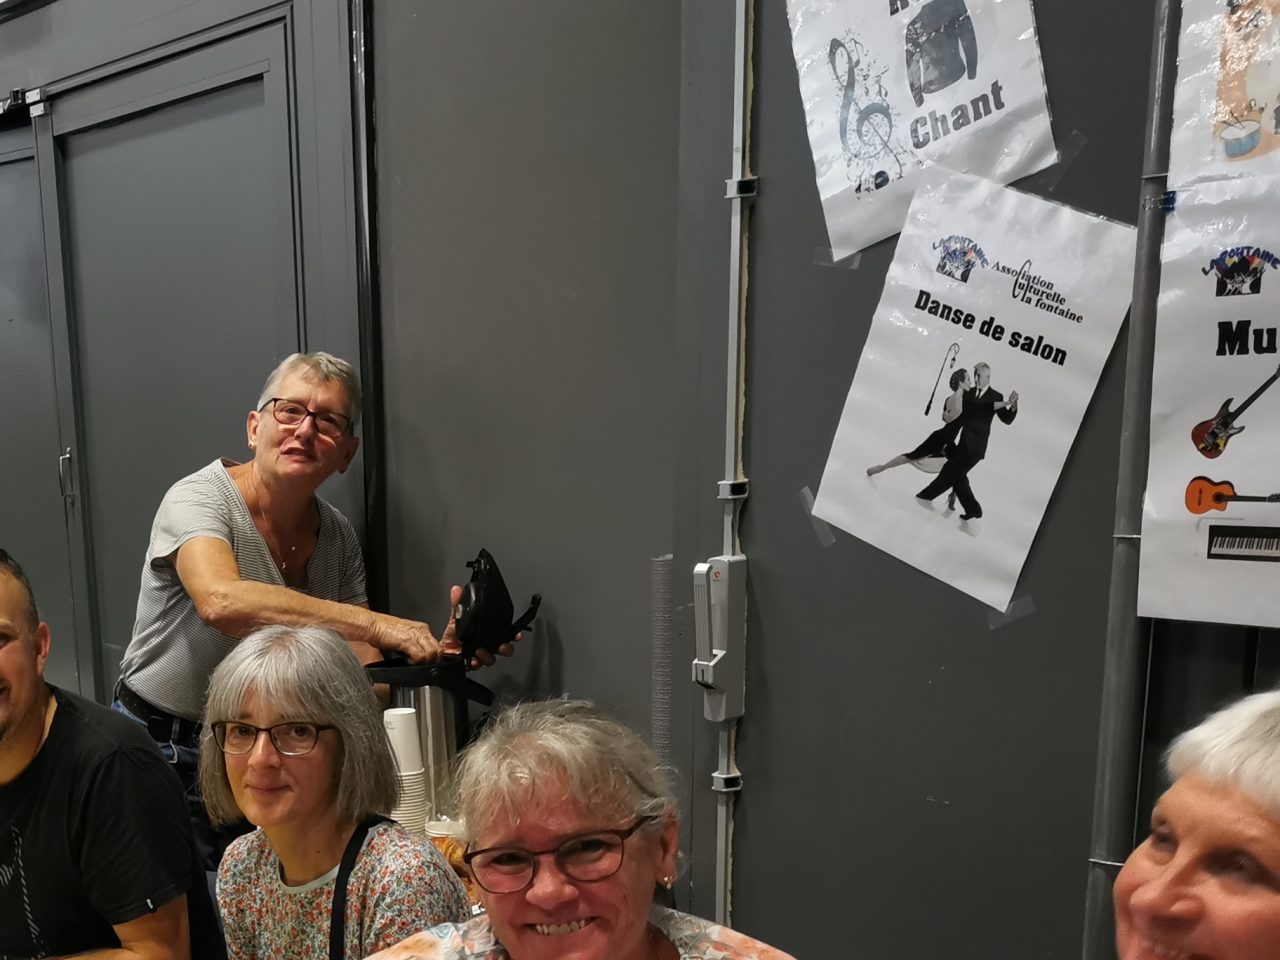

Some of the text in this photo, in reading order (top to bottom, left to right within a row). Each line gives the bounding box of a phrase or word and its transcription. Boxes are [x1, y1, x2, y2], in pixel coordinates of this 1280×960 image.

[910, 80, 1005, 149] Chant
[914, 289, 1067, 366] Danse de salon
[1034, 297, 1083, 324] fontaine
[1216, 320, 1277, 356] Mu
